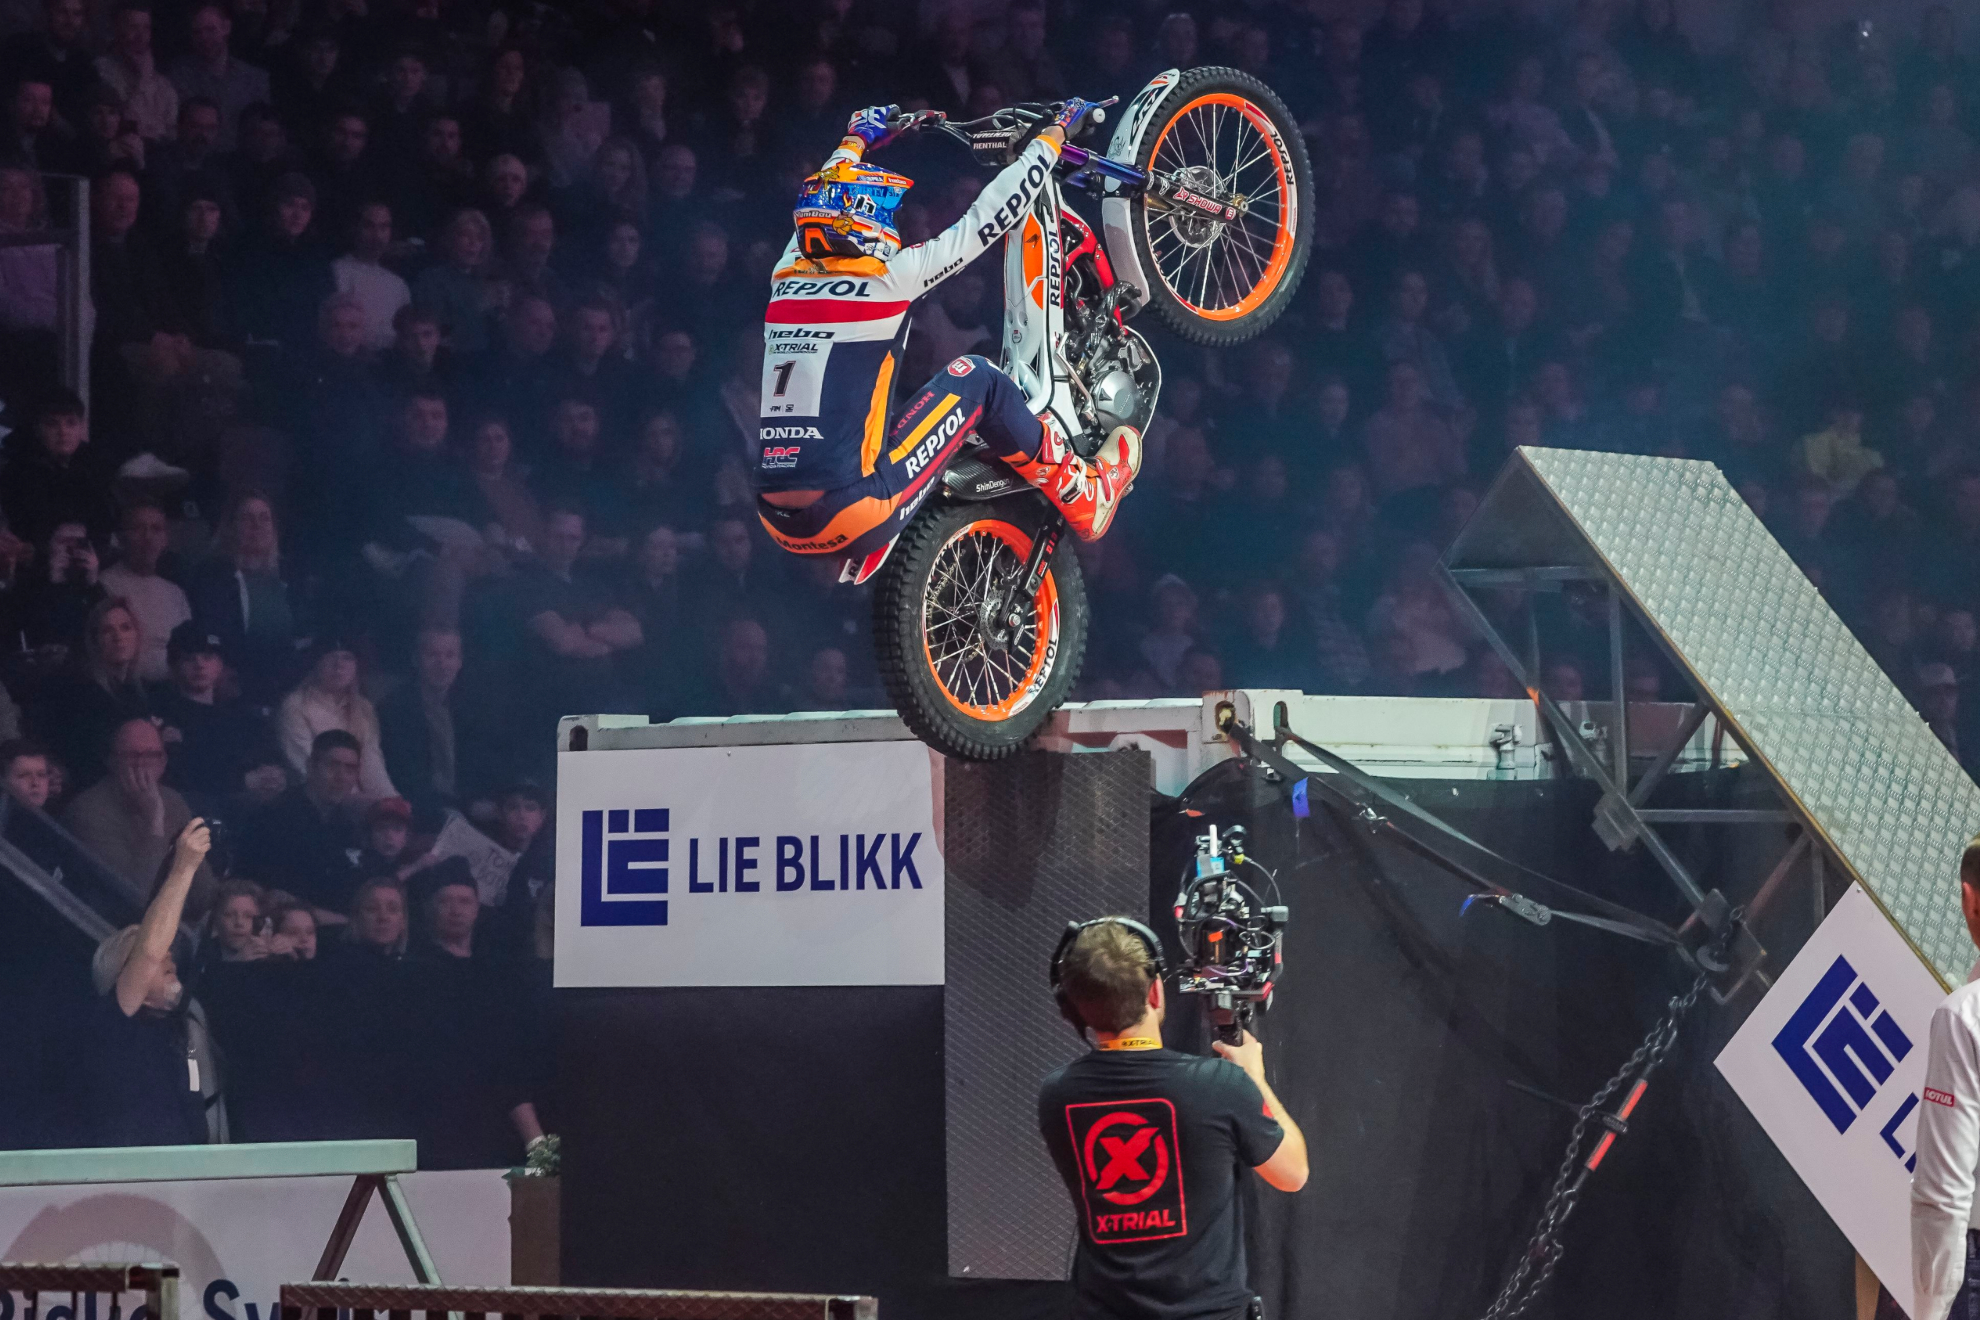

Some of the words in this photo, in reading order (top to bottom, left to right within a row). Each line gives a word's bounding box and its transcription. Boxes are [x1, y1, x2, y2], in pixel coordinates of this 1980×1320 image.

[973, 141, 1007, 150] RENTHAL
[1271, 131, 1295, 186] REPSOL
[977, 154, 1051, 247] REPSOL
[1187, 194, 1222, 214] SHOWA
[923, 257, 964, 288] hebo
[1050, 230, 1061, 308] REPSOL
[772, 280, 871, 298] REPSOL
[768, 328, 835, 340] hebo
[773, 361, 797, 397] 1
[905, 407, 966, 480] REPSOL
[776, 534, 849, 551] Montesa
[1028, 638, 1058, 696] REPSOL
[689, 836, 760, 893] LIE
[776, 832, 923, 892] BLIKK
